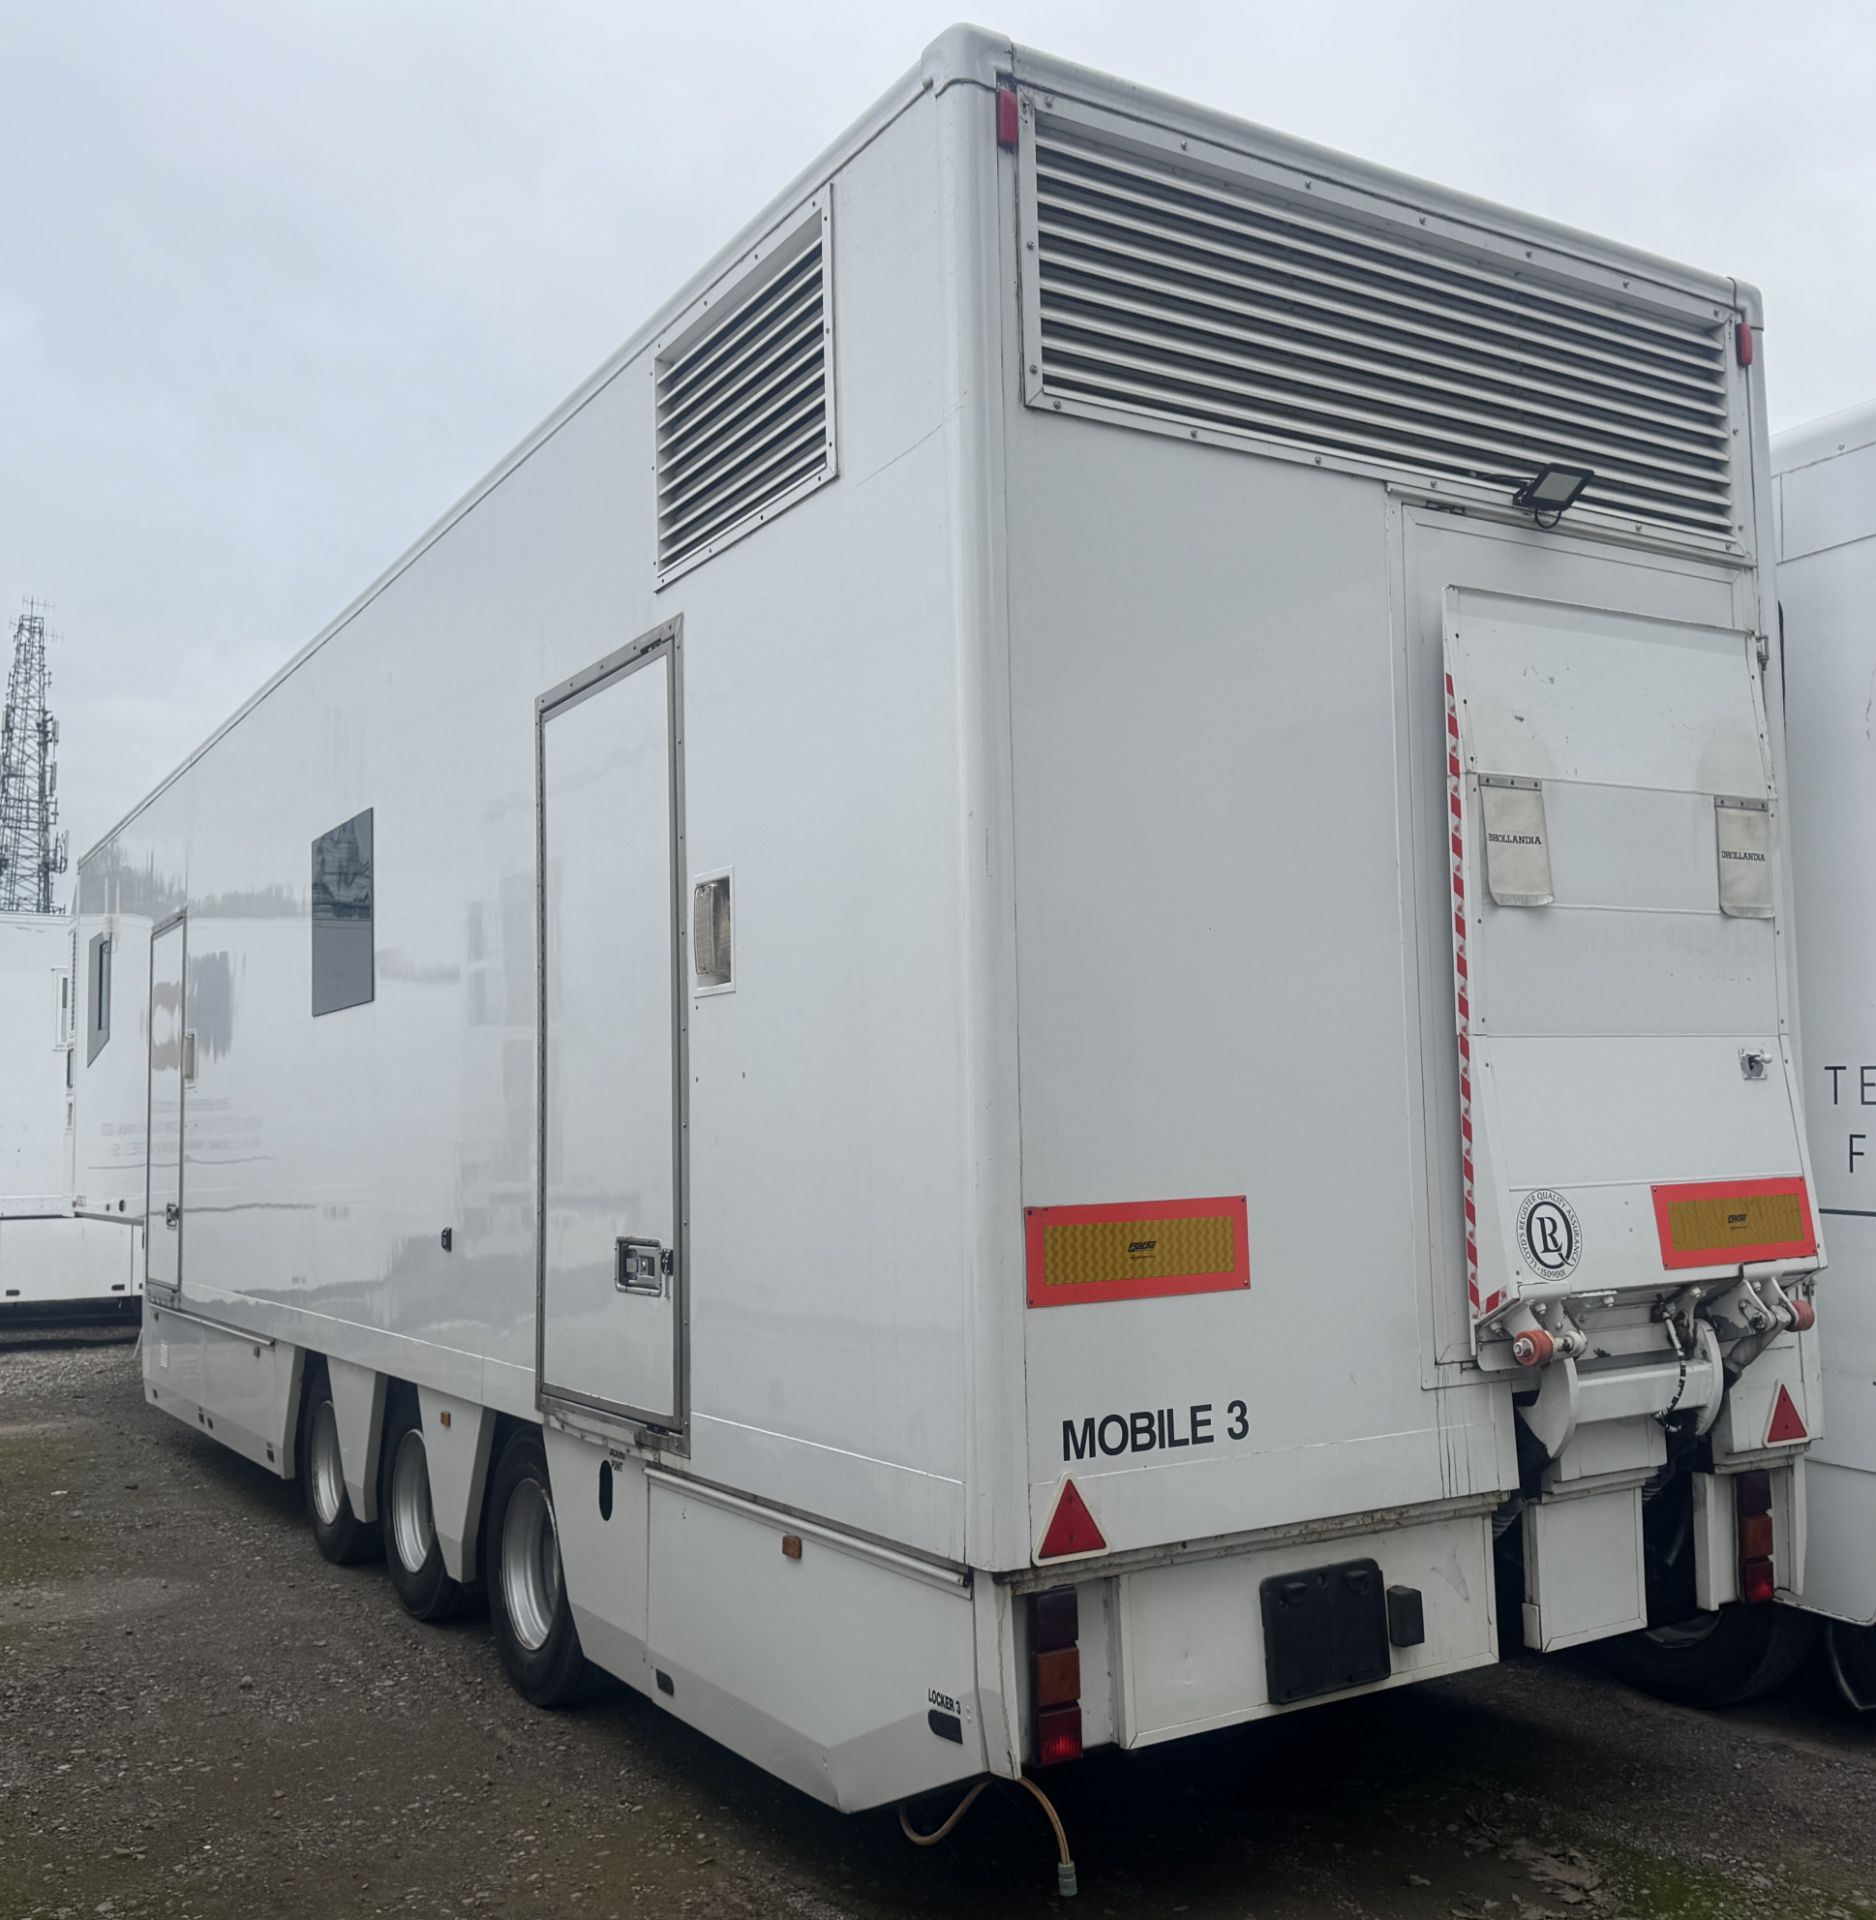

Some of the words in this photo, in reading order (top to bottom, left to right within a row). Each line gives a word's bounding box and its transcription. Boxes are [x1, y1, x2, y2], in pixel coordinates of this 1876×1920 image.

[1721, 850, 1766, 862] DHOLLANDIA
[1849, 1134, 1867, 1173] F
[1518, 1194, 1537, 1231] REGISTER
[1536, 1191, 1567, 1208] QUALITY
[1519, 1232, 1538, 1269] LLOYD'S
[1566, 1209, 1581, 1263] ASSURANCE
[1062, 1404, 1215, 1461] MOBILE
[1226, 1400, 1250, 1440] 3
[928, 1687, 955, 1712] LOCKER
[955, 1700, 961, 1715] 3
